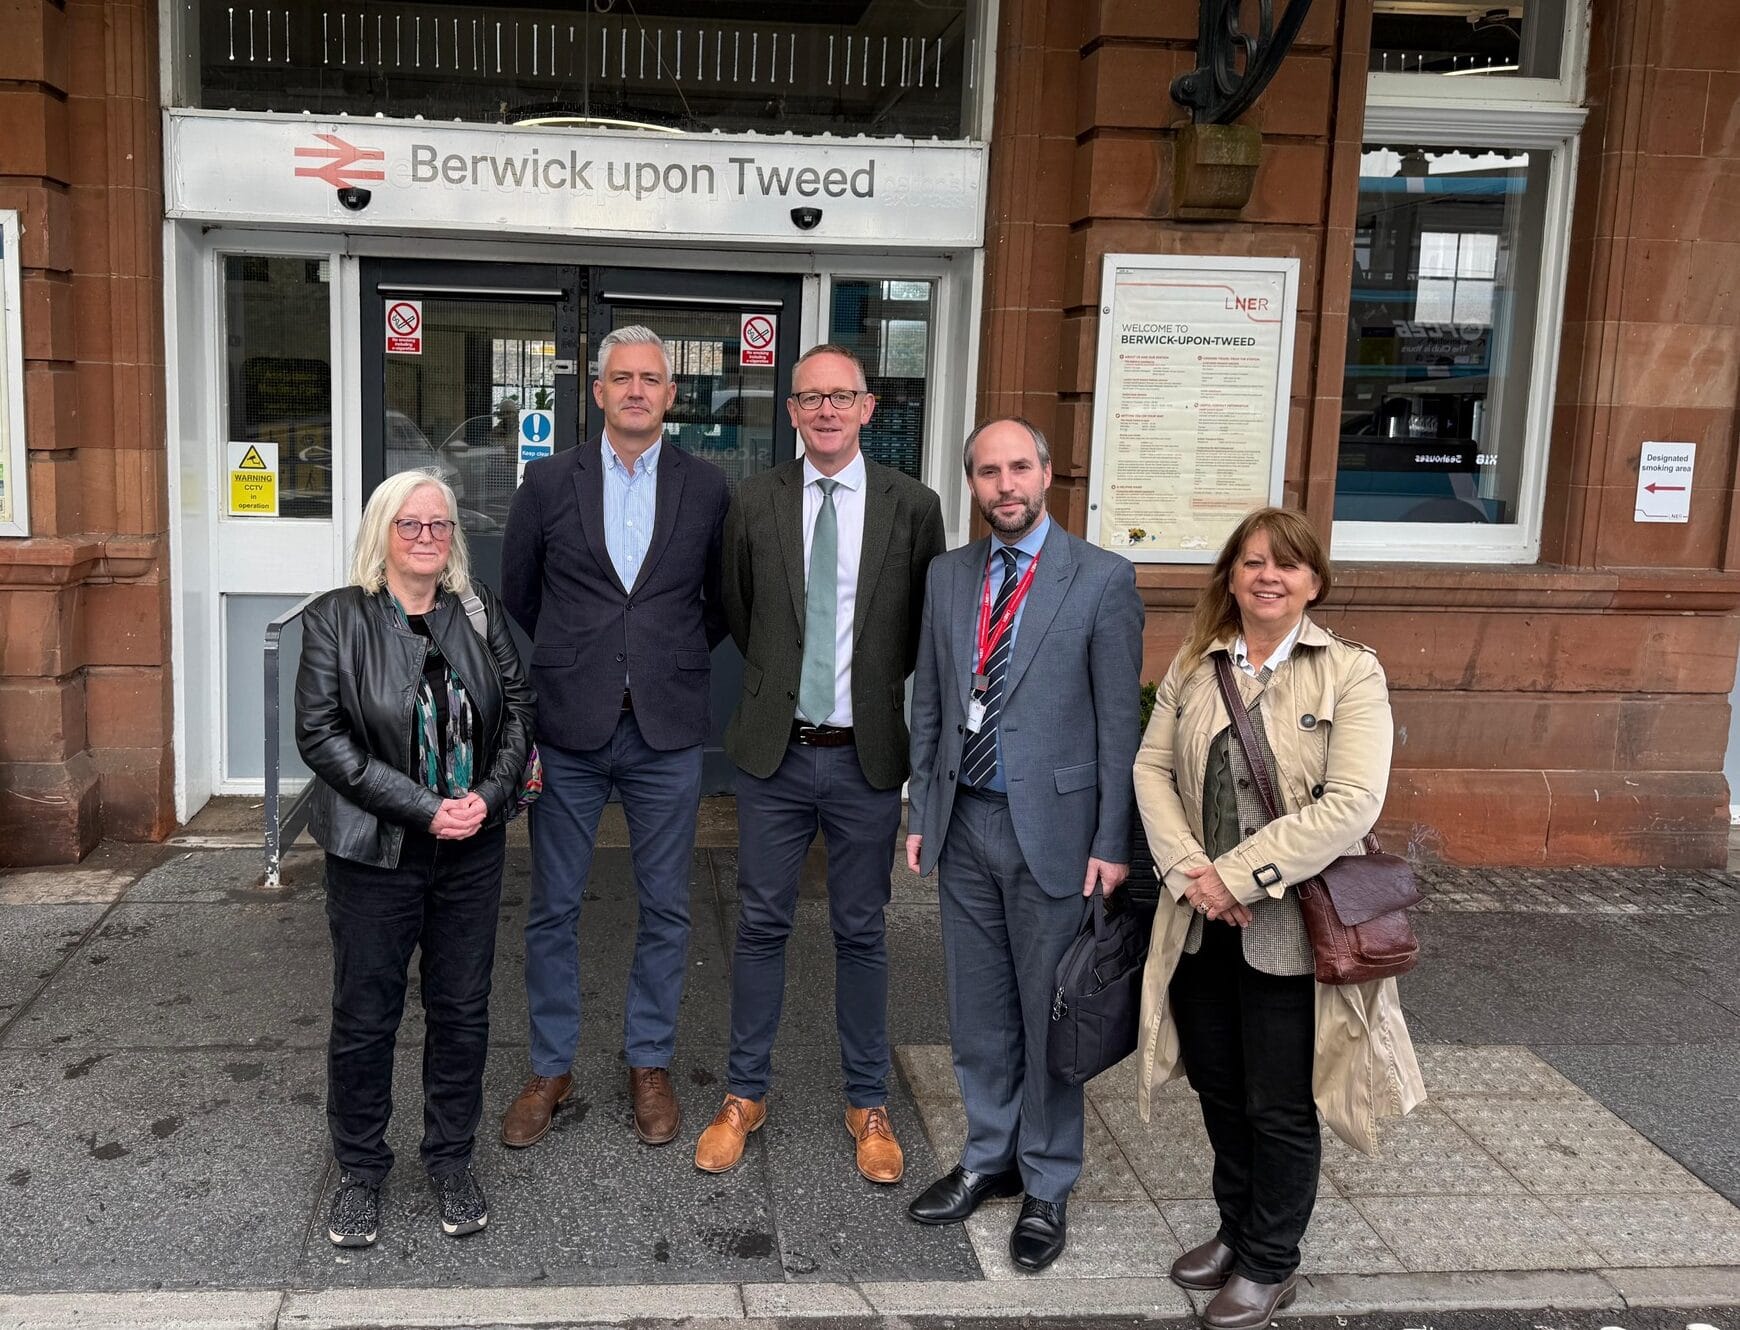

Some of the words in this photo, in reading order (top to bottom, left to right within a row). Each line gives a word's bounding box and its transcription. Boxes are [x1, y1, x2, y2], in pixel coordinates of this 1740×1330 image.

[411, 143, 593, 190] Berwick
[607, 155, 715, 201] upon
[729, 157, 875, 198] Tweed
[1225, 296, 1268, 312] LNER
[1121, 324, 1173, 334] WELCOME
[1176, 324, 1189, 334] TO
[1121, 335, 1256, 347] BERWICK-UPON-TWEED
[1647, 454, 1689, 463] Designated
[1642, 464, 1674, 473] smoking
[234, 474, 272, 482] WARNING
[238, 502, 270, 510] operation
